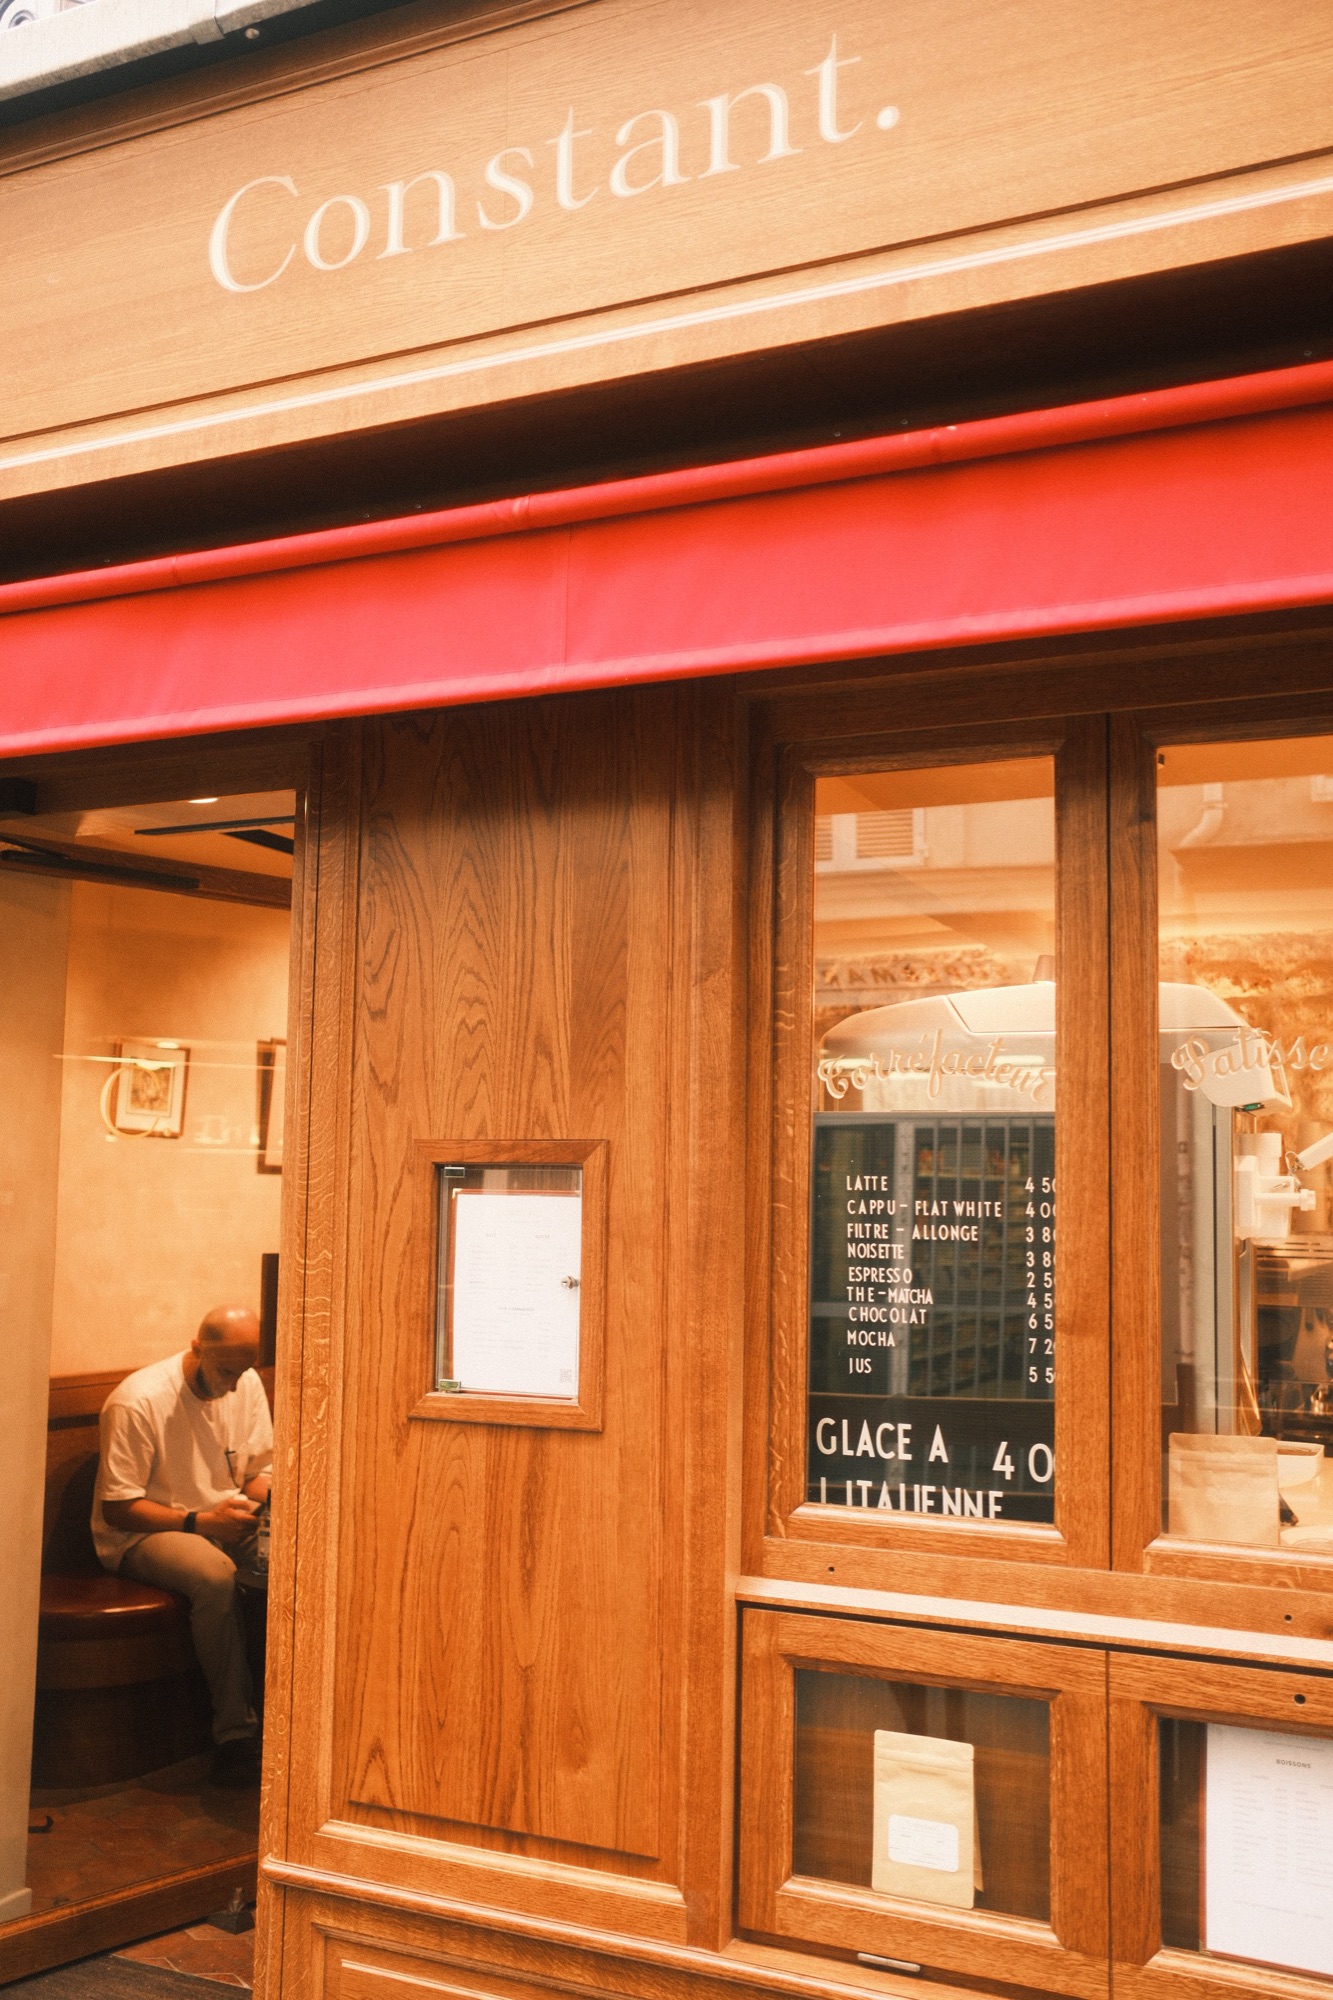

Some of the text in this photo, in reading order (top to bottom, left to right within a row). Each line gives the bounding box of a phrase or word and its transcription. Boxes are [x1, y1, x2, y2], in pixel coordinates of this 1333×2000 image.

[208, 33, 900, 293] Constant.
[817, 1027, 1053, 1102] Torréfacteur
[846, 1175, 888, 1192] LATTE
[1025, 1177, 1035, 1193] 4
[915, 1200, 948, 1217] FLAT
[1025, 1201, 1036, 1218] 4
[847, 1223, 889, 1240] FILTRE
[912, 1224, 979, 1242] ALLONGE
[1025, 1226, 1035, 1243] 3
[1042, 1226, 1056, 1243] 8
[847, 1243, 1056, 1268] NOISETTE 3 8
[848, 1266, 1056, 1289] ESPRESSO 2 5
[1026, 1292, 1037, 1309] 4
[848, 1306, 927, 1325] CHOCOLAT
[1028, 1313, 1038, 1330] 6
[846, 1329, 1055, 1355] MOCHA 7 2
[849, 1357, 1056, 1384] JUS 5 5
[815, 1417, 913, 1462] GLACE
[928, 1423, 949, 1463] A
[991, 1441, 1015, 1481] 4
[1275, 1759, 1311, 1769] BOISSONS
